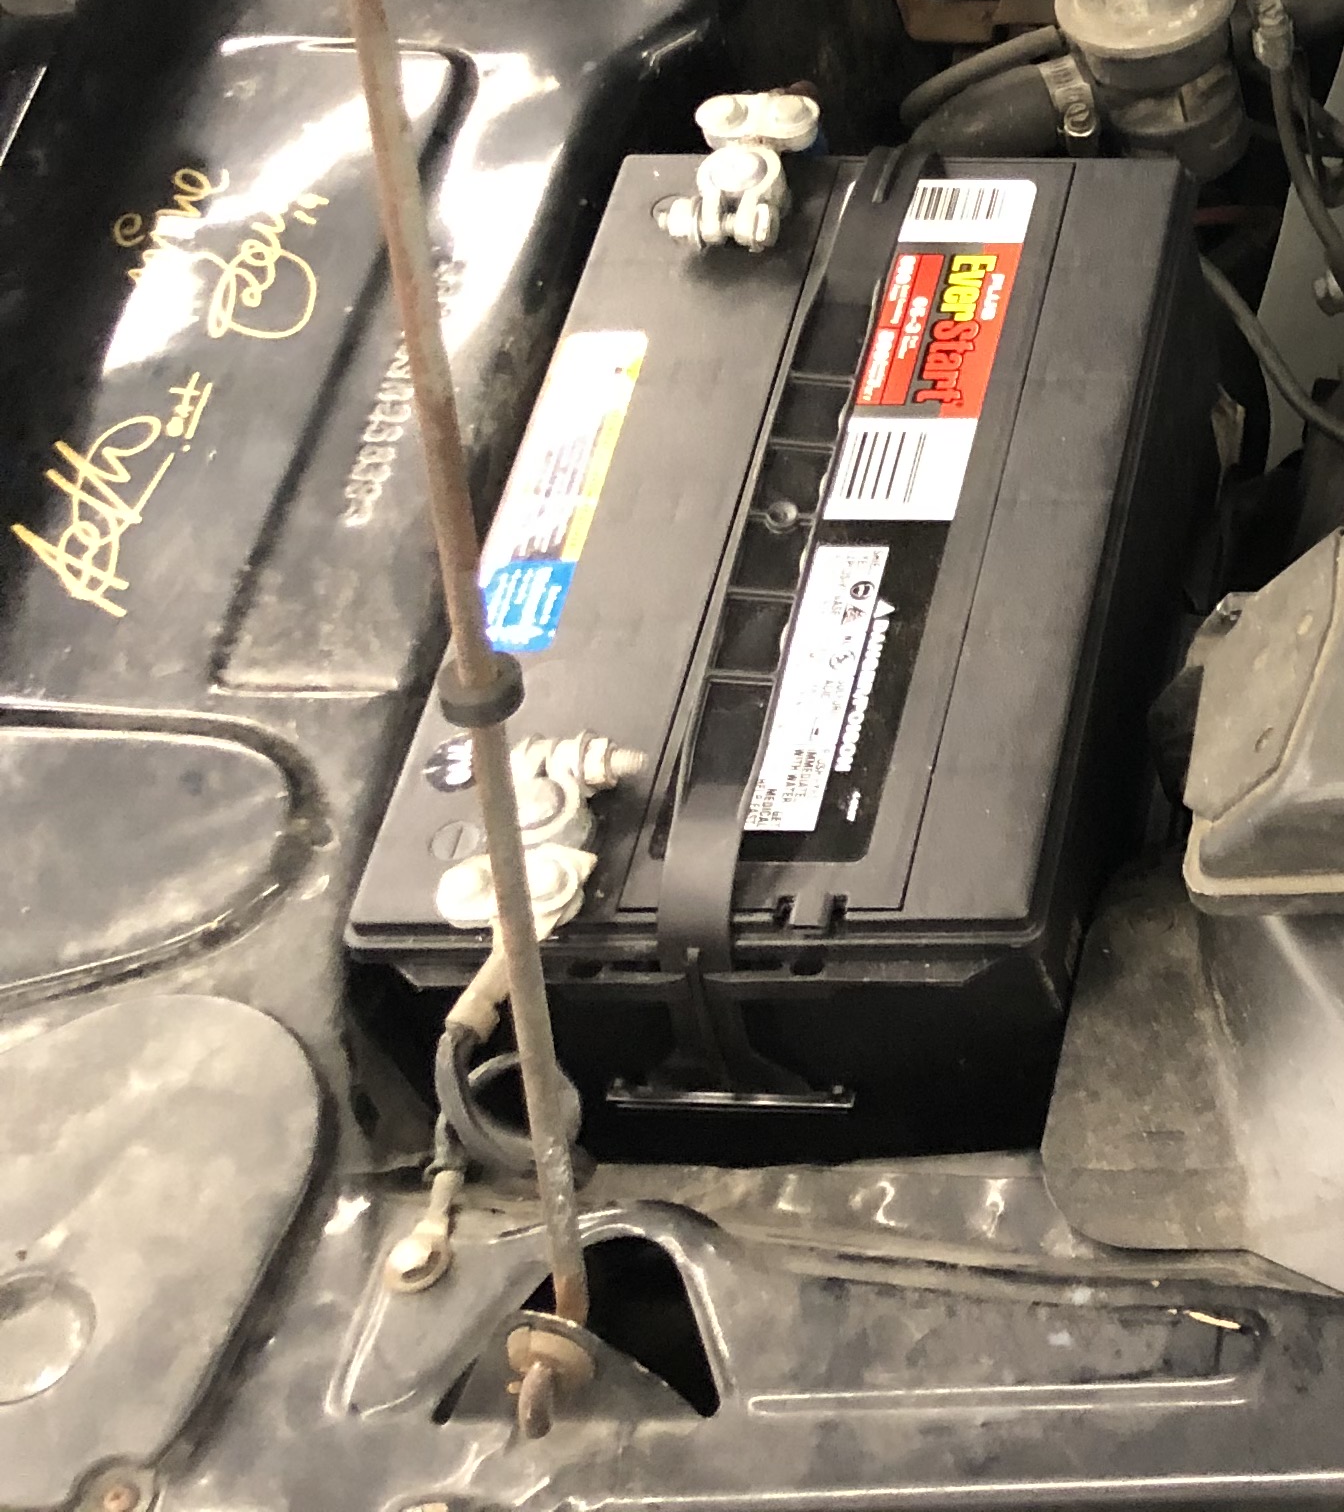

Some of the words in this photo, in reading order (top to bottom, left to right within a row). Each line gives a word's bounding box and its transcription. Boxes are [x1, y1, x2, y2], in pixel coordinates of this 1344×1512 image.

[980, 273, 1006, 321] PLUS
[914, 254, 998, 404] EverStart
[756, 788, 778, 828] MEDICAL
